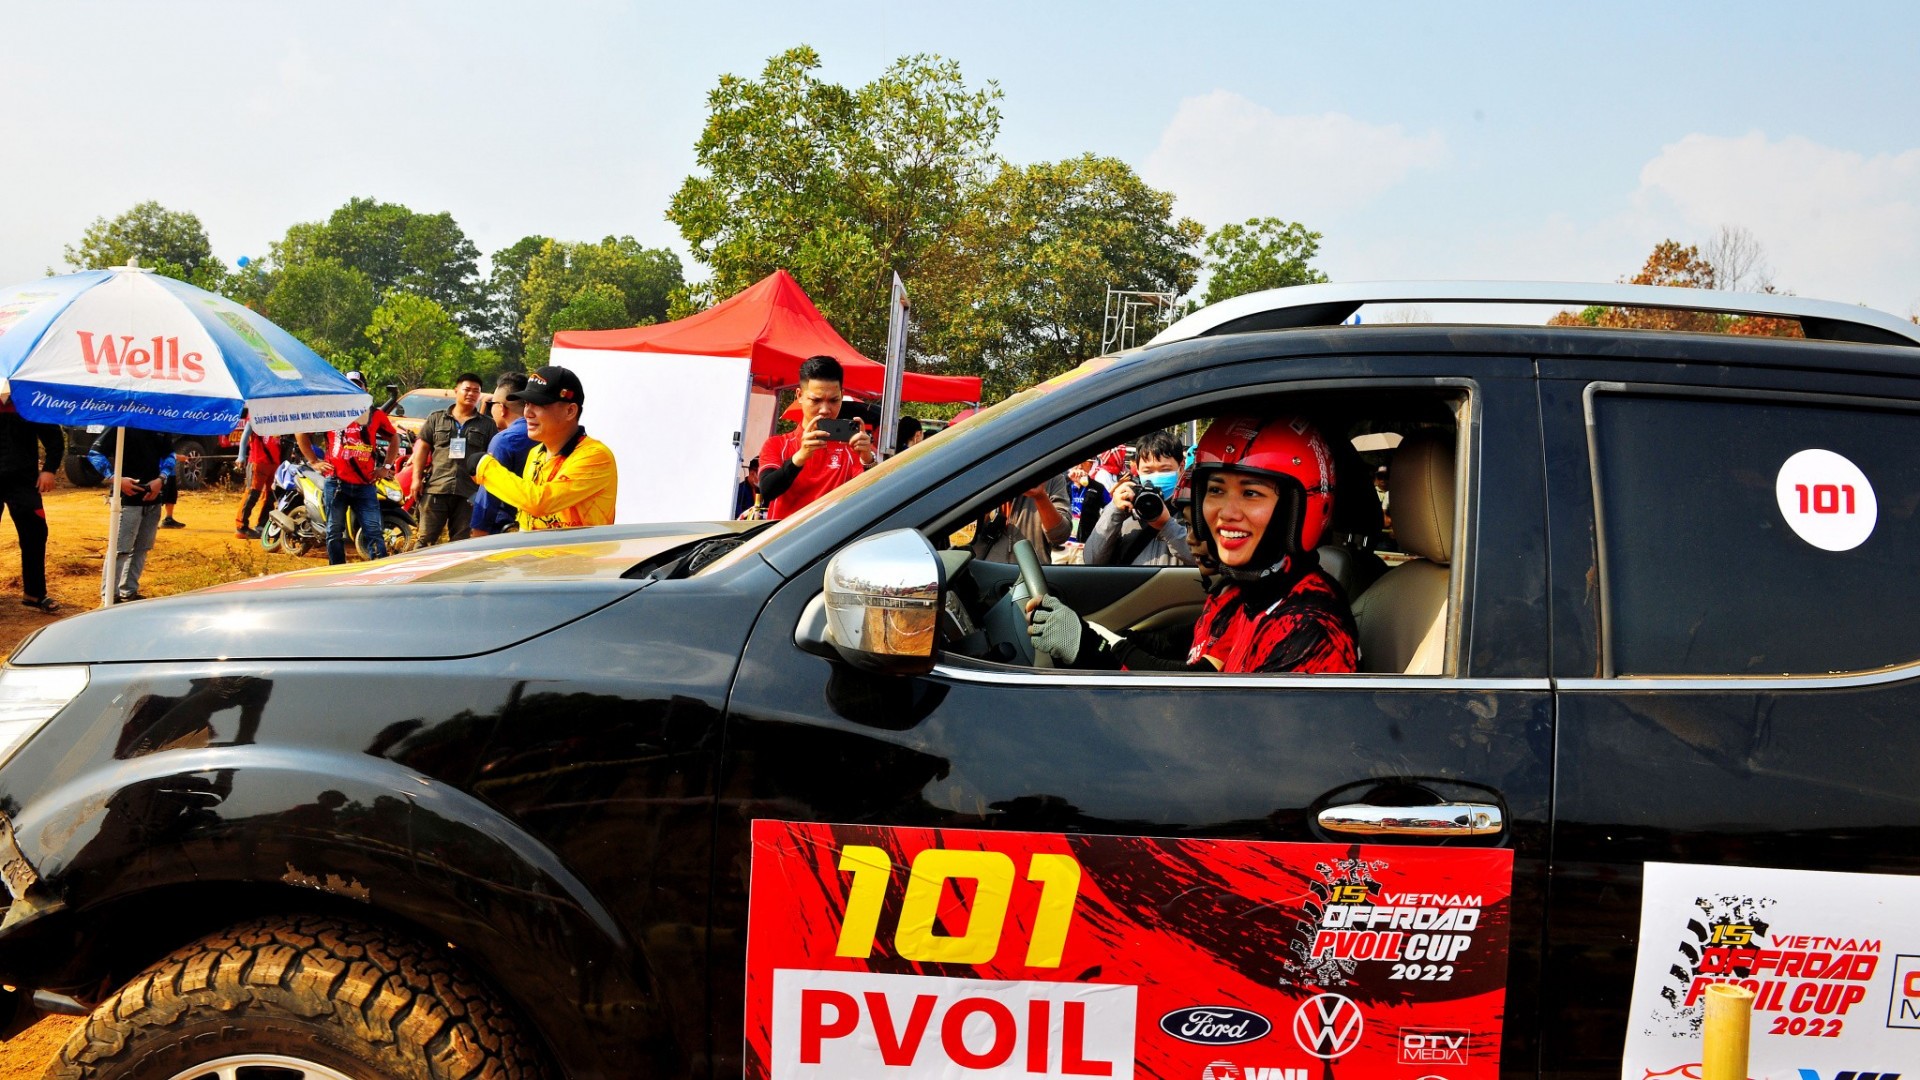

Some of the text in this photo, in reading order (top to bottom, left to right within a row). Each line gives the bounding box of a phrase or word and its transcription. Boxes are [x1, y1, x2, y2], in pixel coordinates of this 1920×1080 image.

[76, 330, 206, 383] Wells
[31, 390, 77, 415] Mang
[80, 398, 114, 412] thiên
[117, 401, 154, 414] nhiên
[157, 405, 180, 418] vào
[182, 408, 211, 422] cuộc
[212, 408, 241, 429] sống
[1795, 484, 1855, 514] 101
[835, 844, 1081, 968] 101
[1331, 886, 1483, 907] 15 VIETNAM
[1322, 905, 1481, 931] OFFROAD
[1311, 930, 1472, 962] PVOIL CUP
[1711, 924, 1881, 952] 15 VIETNAM
[1388, 963, 1454, 982] 2022
[1698, 947, 1879, 981] OFFROAD
[1788, 982, 1866, 1015] CUP
[800, 989, 1113, 1077] PVOIL
[1181, 1010, 1250, 1038] Ford
[1768, 1016, 1843, 1038] 2022
[1404, 1034, 1465, 1049] OTV
[1404, 1048, 1464, 1064] MEDIA
